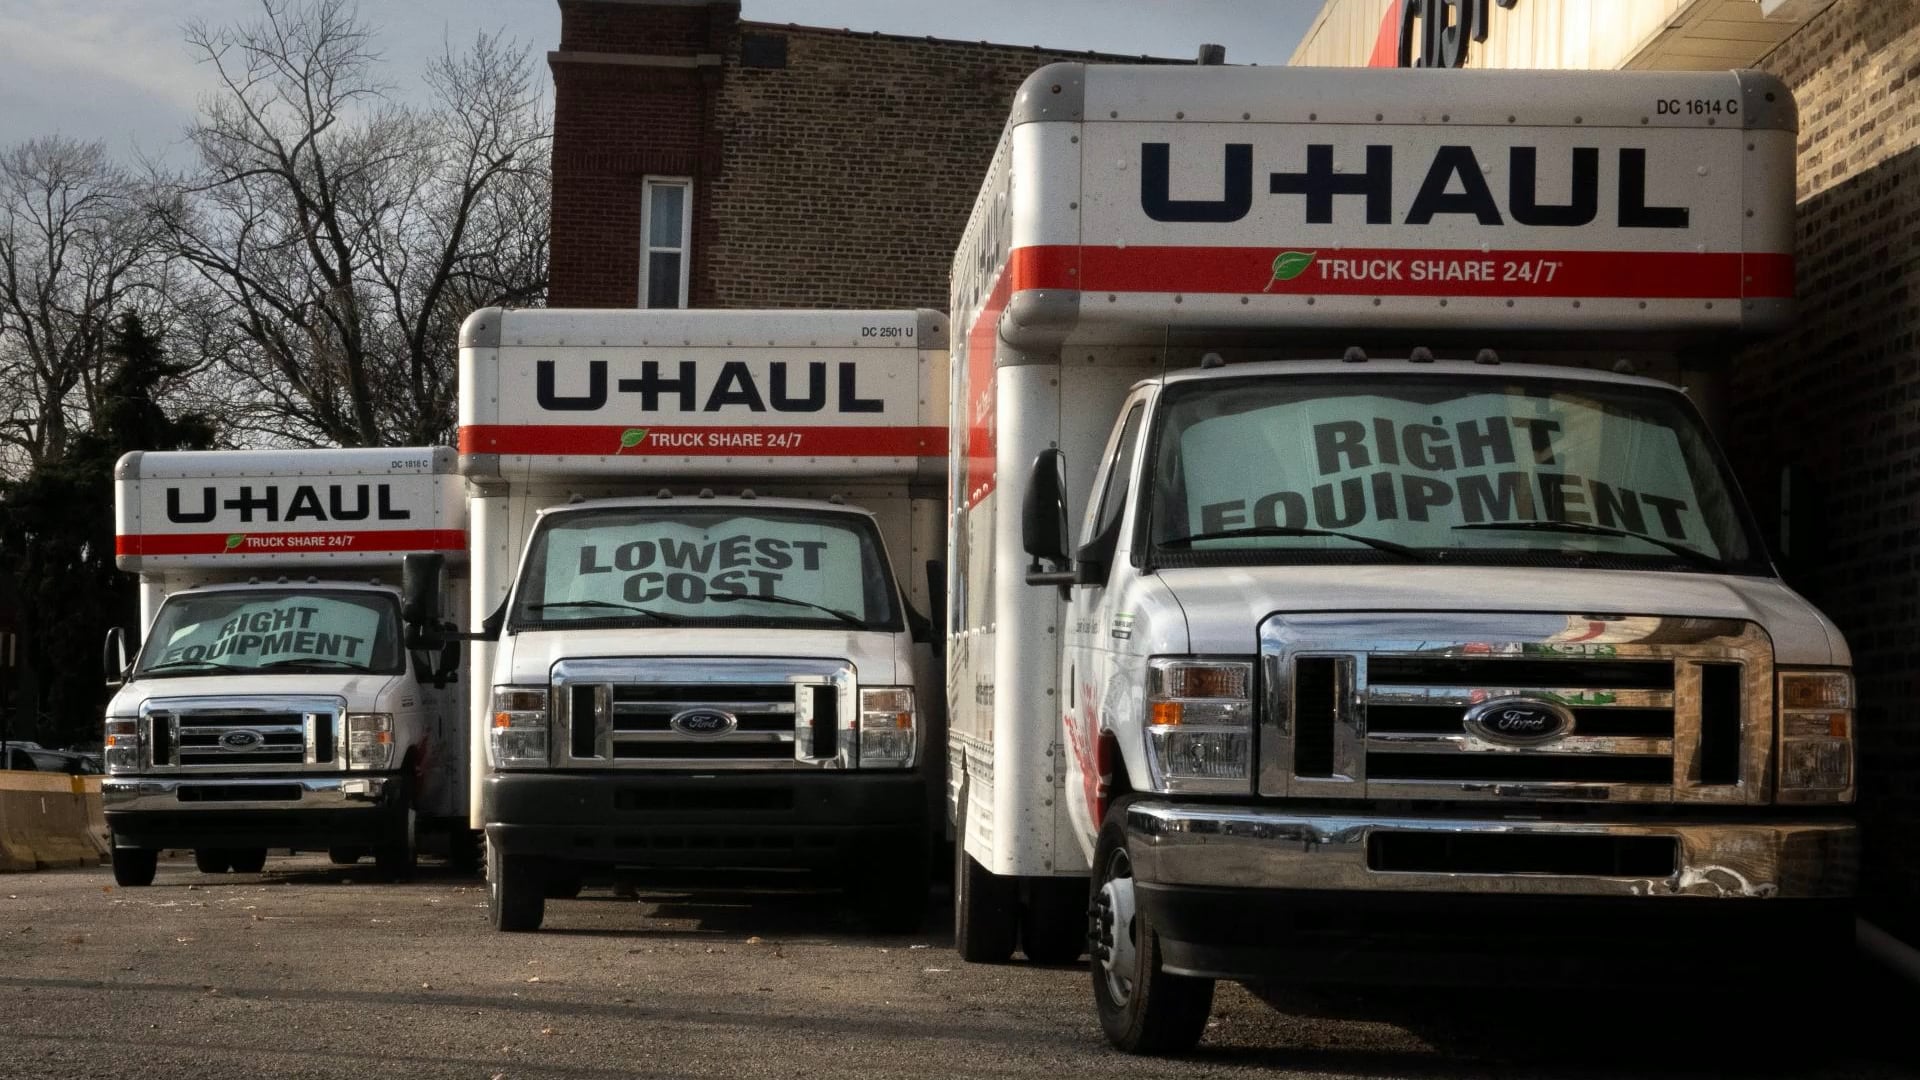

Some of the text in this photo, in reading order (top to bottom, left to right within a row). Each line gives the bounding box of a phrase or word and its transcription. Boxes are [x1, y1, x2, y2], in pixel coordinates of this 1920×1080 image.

[1656, 99, 1739, 115] DC 1614 C
[1140, 142, 1690, 229] U-HAUL
[1317, 258, 1403, 281] TRUCK
[1410, 260, 1496, 282] SHARE
[861, 326, 914, 337] DC 2501 U
[536, 360, 885, 413] U-HAUL
[649, 432, 802, 448] TRUCK SHARE 24/7
[1312, 416, 1561, 475] RIGHT
[166, 484, 411, 524] U-HAUL
[1200, 471, 1688, 541] EQUIPMENT
[246, 537, 285, 548] TRUCK
[287, 536, 325, 547] SHARE
[579, 535, 828, 576] LOWEST
[622, 570, 783, 605] COST
[216, 606, 319, 641] RIGHT
[161, 631, 364, 664] EQUIPMENT
[688, 715, 719, 729] Ford
[1498, 710, 1546, 729] Ford
